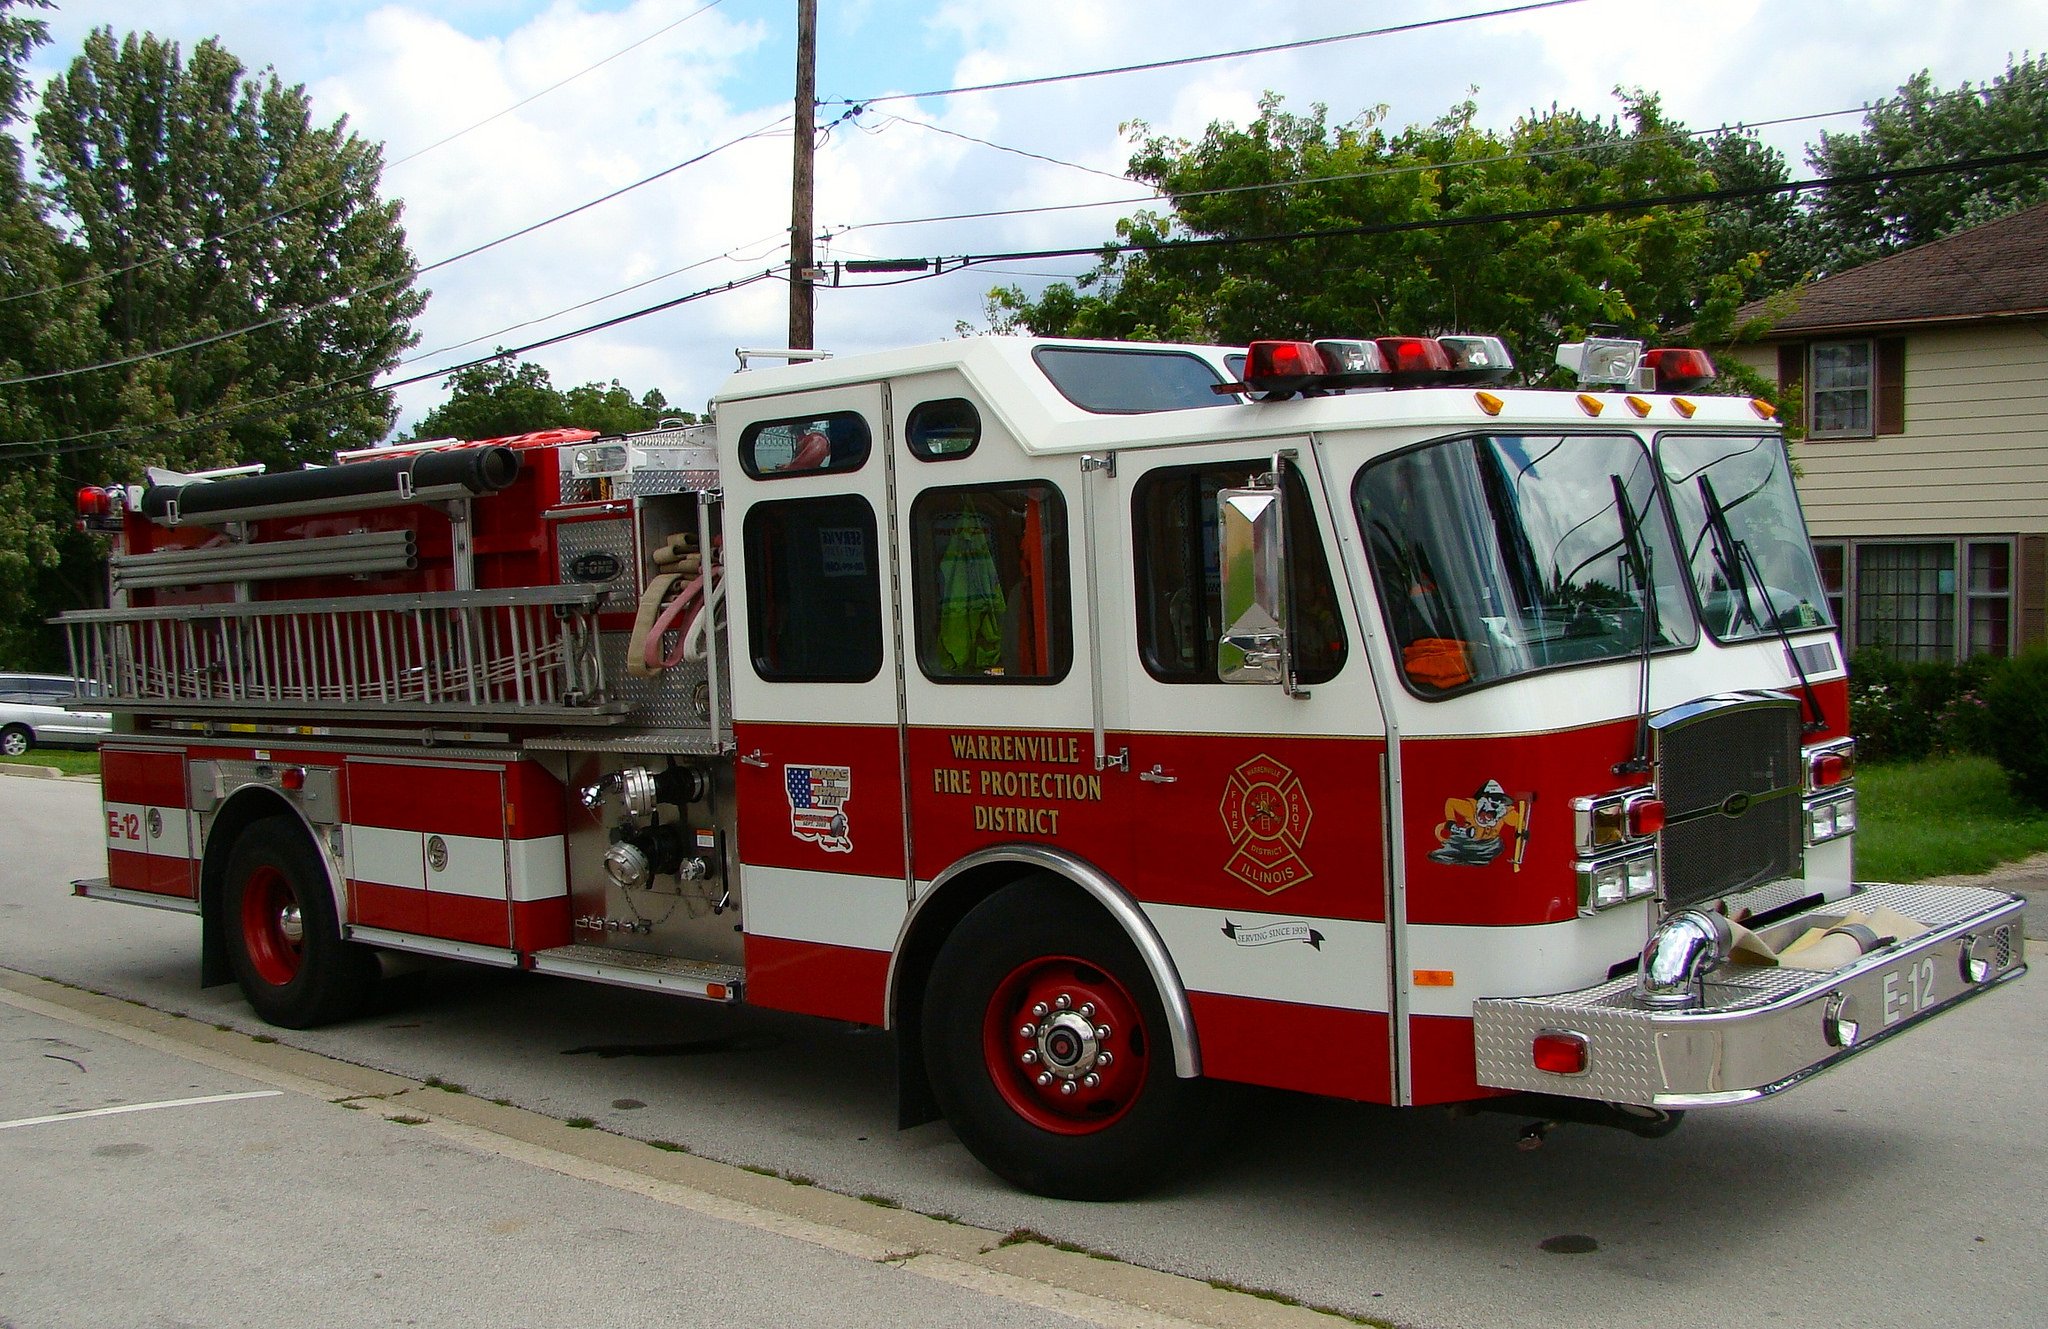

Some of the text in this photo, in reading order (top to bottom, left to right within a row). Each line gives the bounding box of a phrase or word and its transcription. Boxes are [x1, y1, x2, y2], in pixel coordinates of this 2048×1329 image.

[950, 734, 1080, 763] WARRENVILLE
[934, 768, 1101, 800] FIRE PROTECTION
[107, 811, 140, 840] E-12
[974, 805, 1059, 835] DISTRICT
[1251, 844, 1282, 856] DISTRICT
[1241, 863, 1294, 883] ILLINOIS
[1237, 931, 1268, 943] SERVING
[1269, 927, 1291, 938] SINCE
[1882, 957, 1935, 1027] E-12
